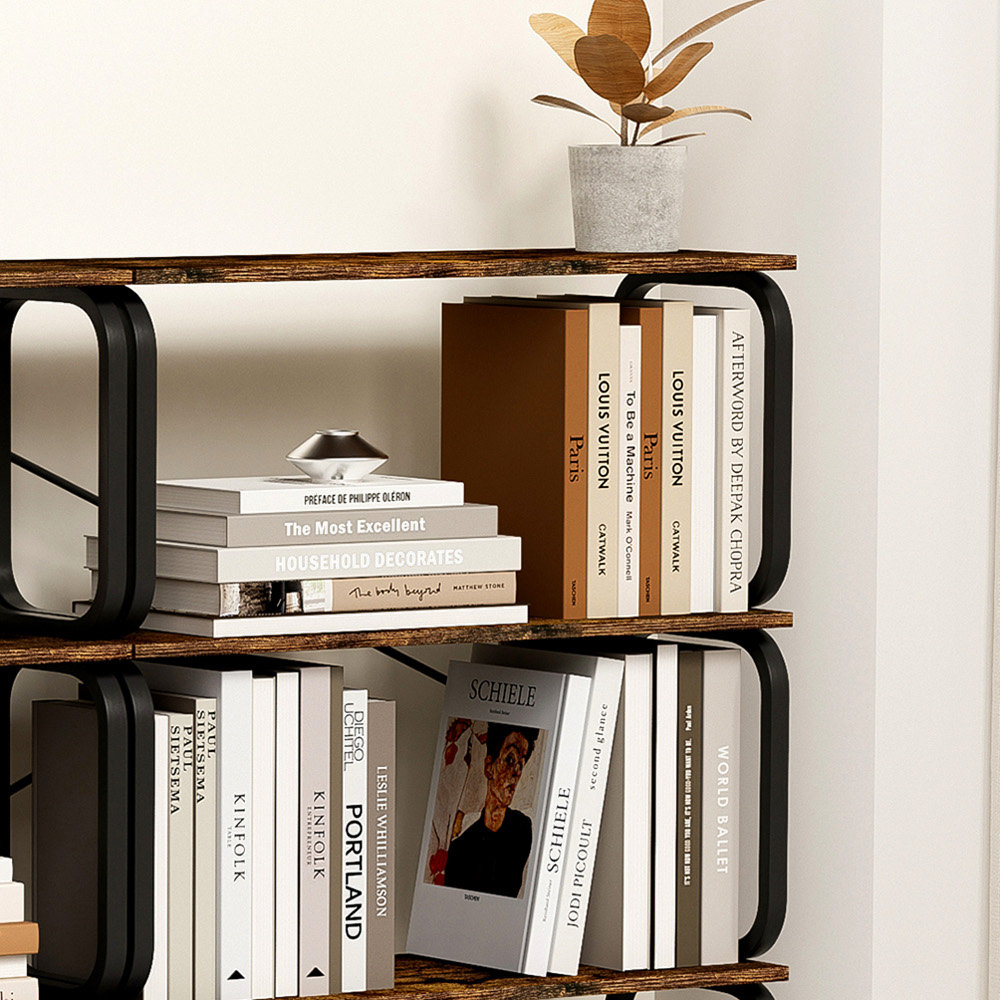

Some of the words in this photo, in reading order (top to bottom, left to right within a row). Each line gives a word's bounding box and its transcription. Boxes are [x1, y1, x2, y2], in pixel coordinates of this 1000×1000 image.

[598, 372, 610, 419] LOUIS
[626, 391, 636, 406] To
[672, 371, 684, 417] LOUIS
[731, 331, 745, 432] AFTERWORD
[626, 410, 636, 429] Be
[626, 433, 634, 441] a
[569, 435, 584, 482] Paris
[598, 423, 610, 489] VUITTON
[643, 433, 658, 480] Paris
[672, 421, 684, 486] VUITTON
[731, 438, 744, 458] BY
[337, 493, 347, 504] DE
[349, 491, 381, 504] PHILIPPE
[626, 446, 636, 503] Machine
[730, 463, 743, 523] DEEPAK
[284, 521, 310, 537] The
[315, 520, 353, 535] Most
[357, 517, 426, 533] Excellent
[625, 511, 634, 533] Mark
[275, 553, 370, 572] HOUSEHOLD
[375, 549, 464, 567] DECORATES
[625, 536, 633, 581] O'Connell
[729, 529, 743, 593] CHOPRA
[376, 583, 400, 597] body
[468, 678, 537, 707] SCHIELE
[170, 726, 181, 814] SIETSEMA
[196, 710, 206, 803] SIETSEMA
[716, 745, 730, 808] WORLD
[233, 793, 246, 882] KINFOLK
[313, 791, 326, 879] KINFOLK
[547, 787, 571, 873] SCHIELE
[716, 815, 729, 874] BALLET
[345, 804, 363, 940] PORTLAND
